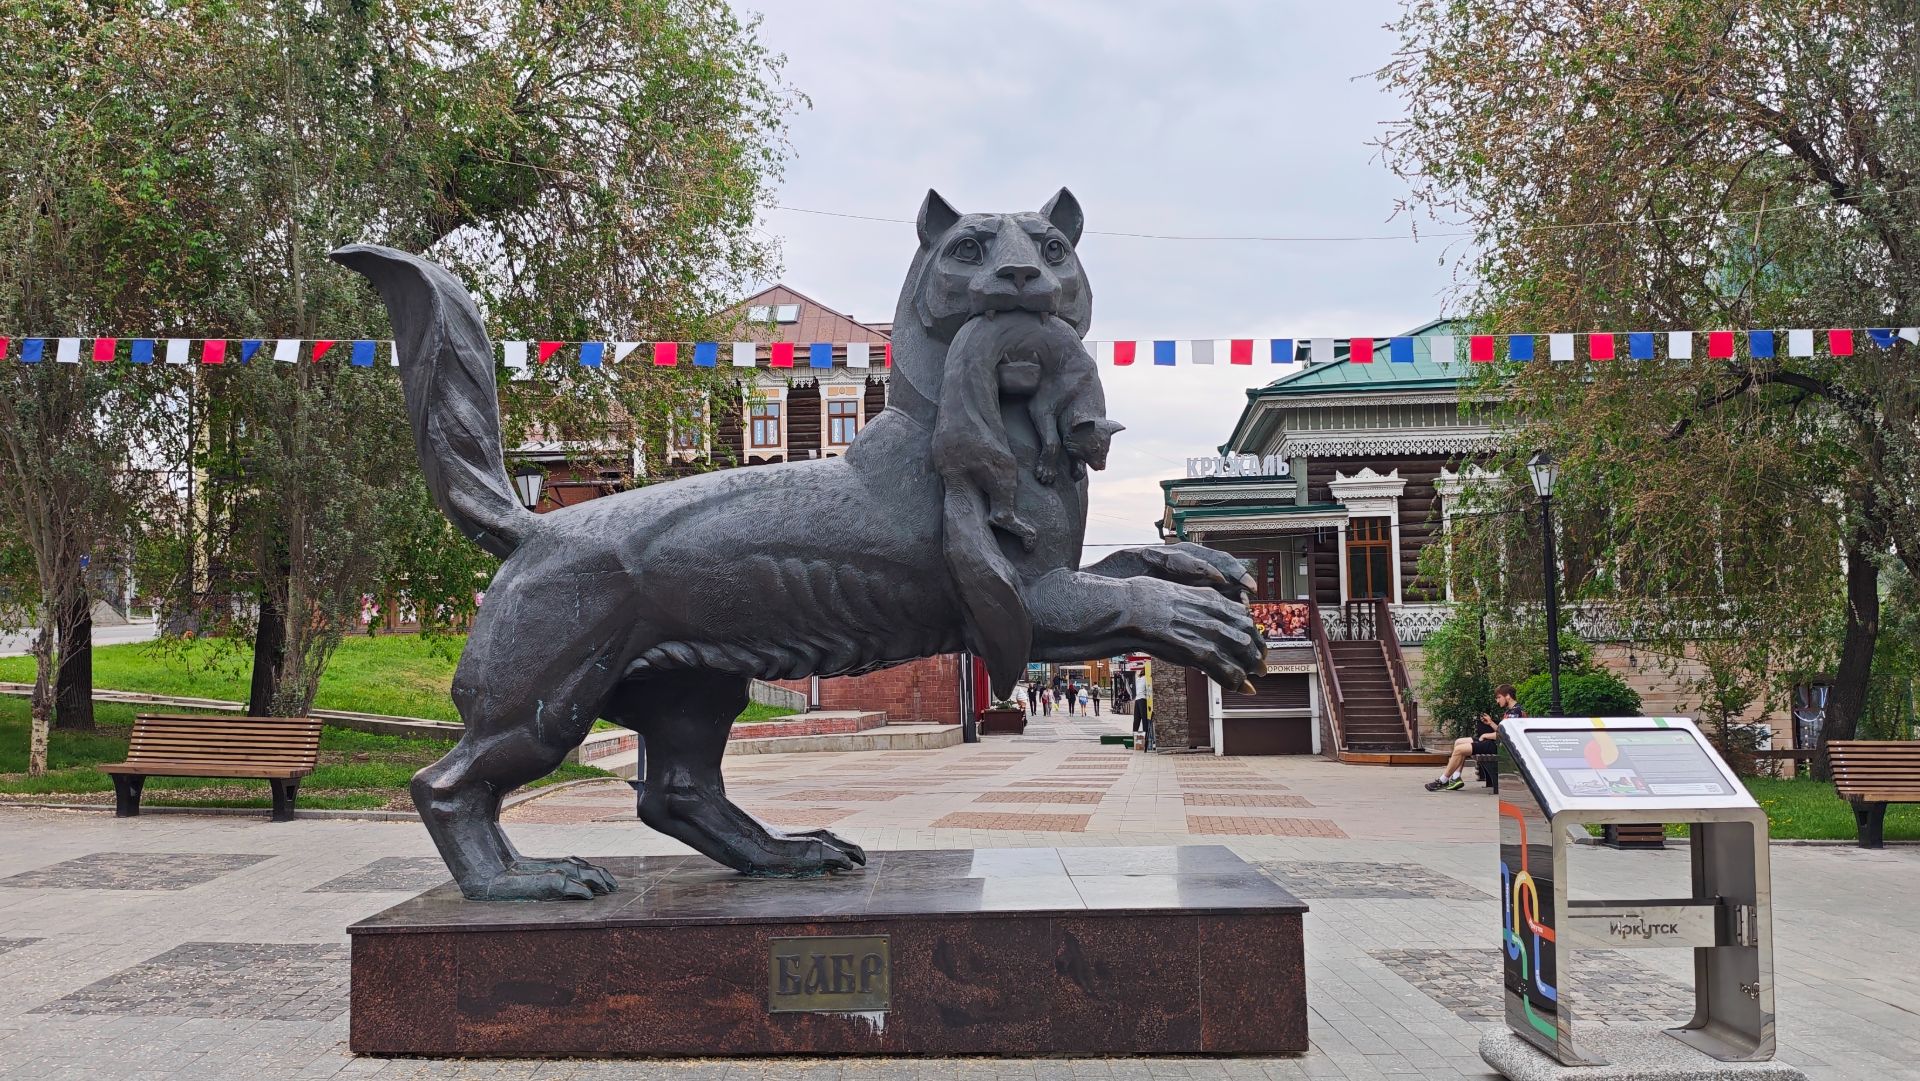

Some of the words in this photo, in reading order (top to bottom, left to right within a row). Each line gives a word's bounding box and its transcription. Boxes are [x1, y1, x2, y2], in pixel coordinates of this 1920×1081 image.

[1186, 453, 1290, 478] КРУЖАЛЬ
[1609, 918, 1679, 940] Иркутск
[775, 952, 883, 996] БАБР
